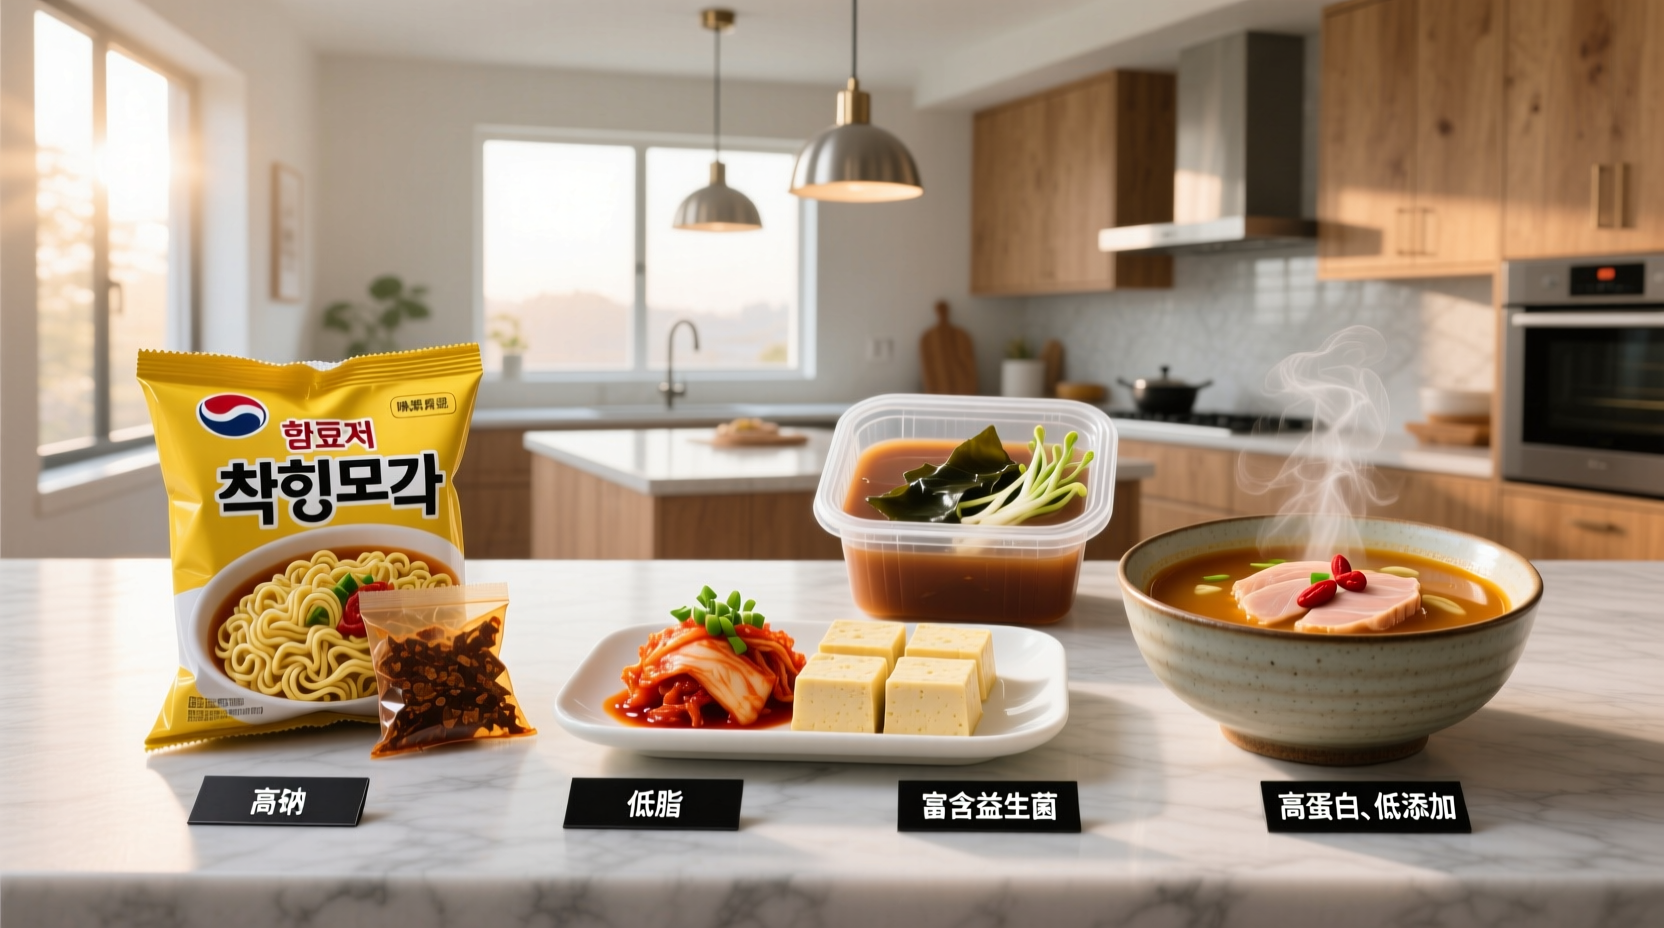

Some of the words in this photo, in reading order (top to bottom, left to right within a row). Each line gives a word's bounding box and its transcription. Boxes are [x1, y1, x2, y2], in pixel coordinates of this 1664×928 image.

[627, 790, 684, 819] 低脂
[922, 791, 1058, 820] 富含益生菌
[1278, 791, 1457, 821] 高蛋白、低添加
